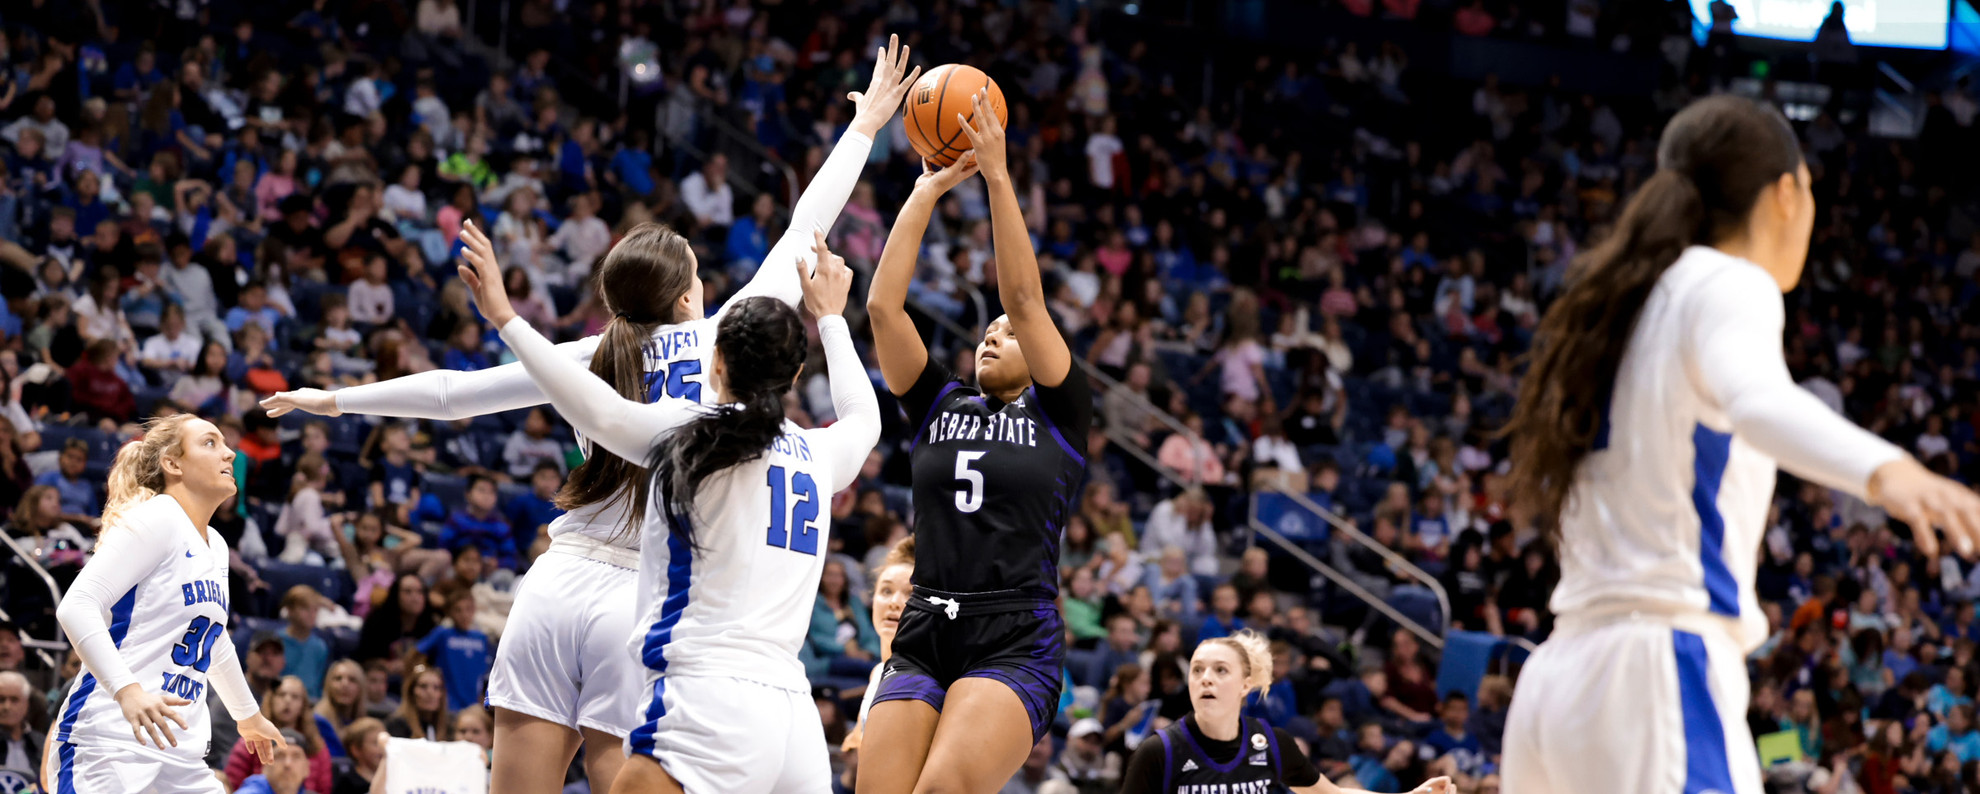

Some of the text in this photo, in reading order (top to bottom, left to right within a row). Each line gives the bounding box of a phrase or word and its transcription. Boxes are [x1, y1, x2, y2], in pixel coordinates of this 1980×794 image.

[929, 412, 1036, 447] WEBER STATE
[766, 464, 819, 556] 12
[955, 450, 988, 513] 5
